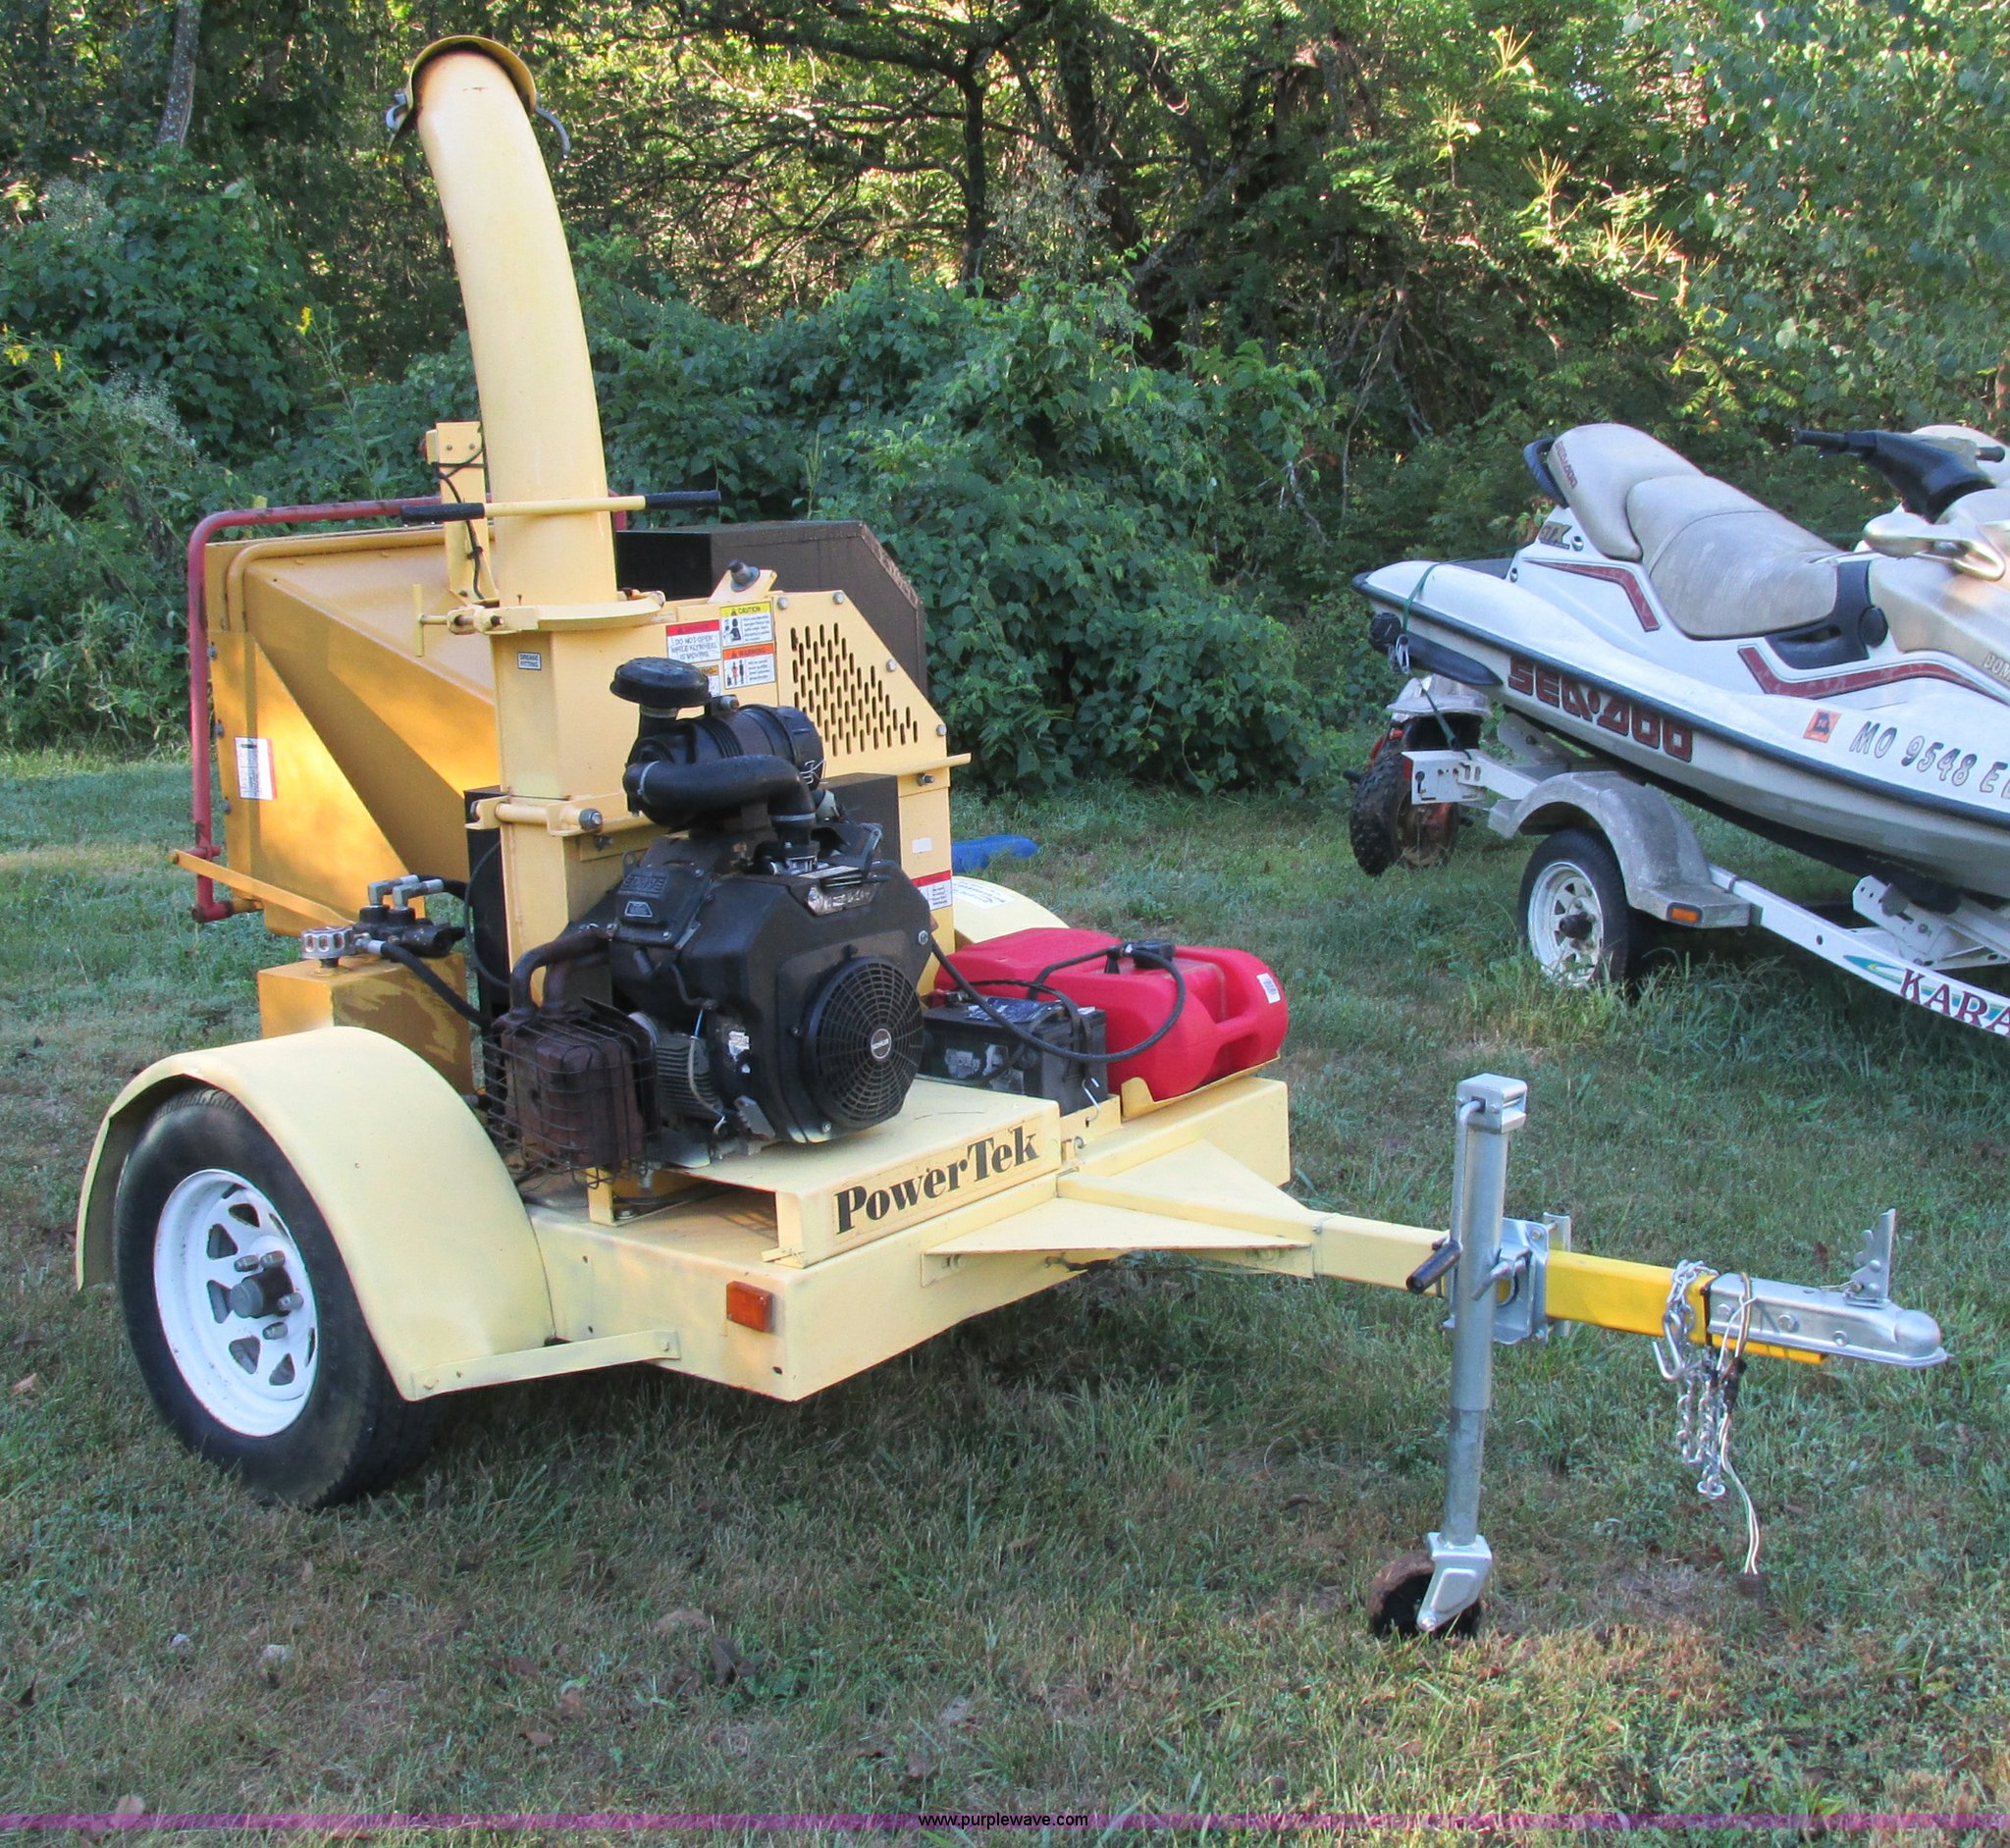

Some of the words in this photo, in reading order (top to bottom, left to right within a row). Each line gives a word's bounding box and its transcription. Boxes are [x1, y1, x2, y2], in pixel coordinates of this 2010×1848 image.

[738, 606, 761, 614] CAUTION
[697, 634, 714, 643] OPEN
[1849, 721, 1897, 759] MO
[1901, 735, 1978, 786] 9548
[834, 1126, 1039, 1235] PowerTek
